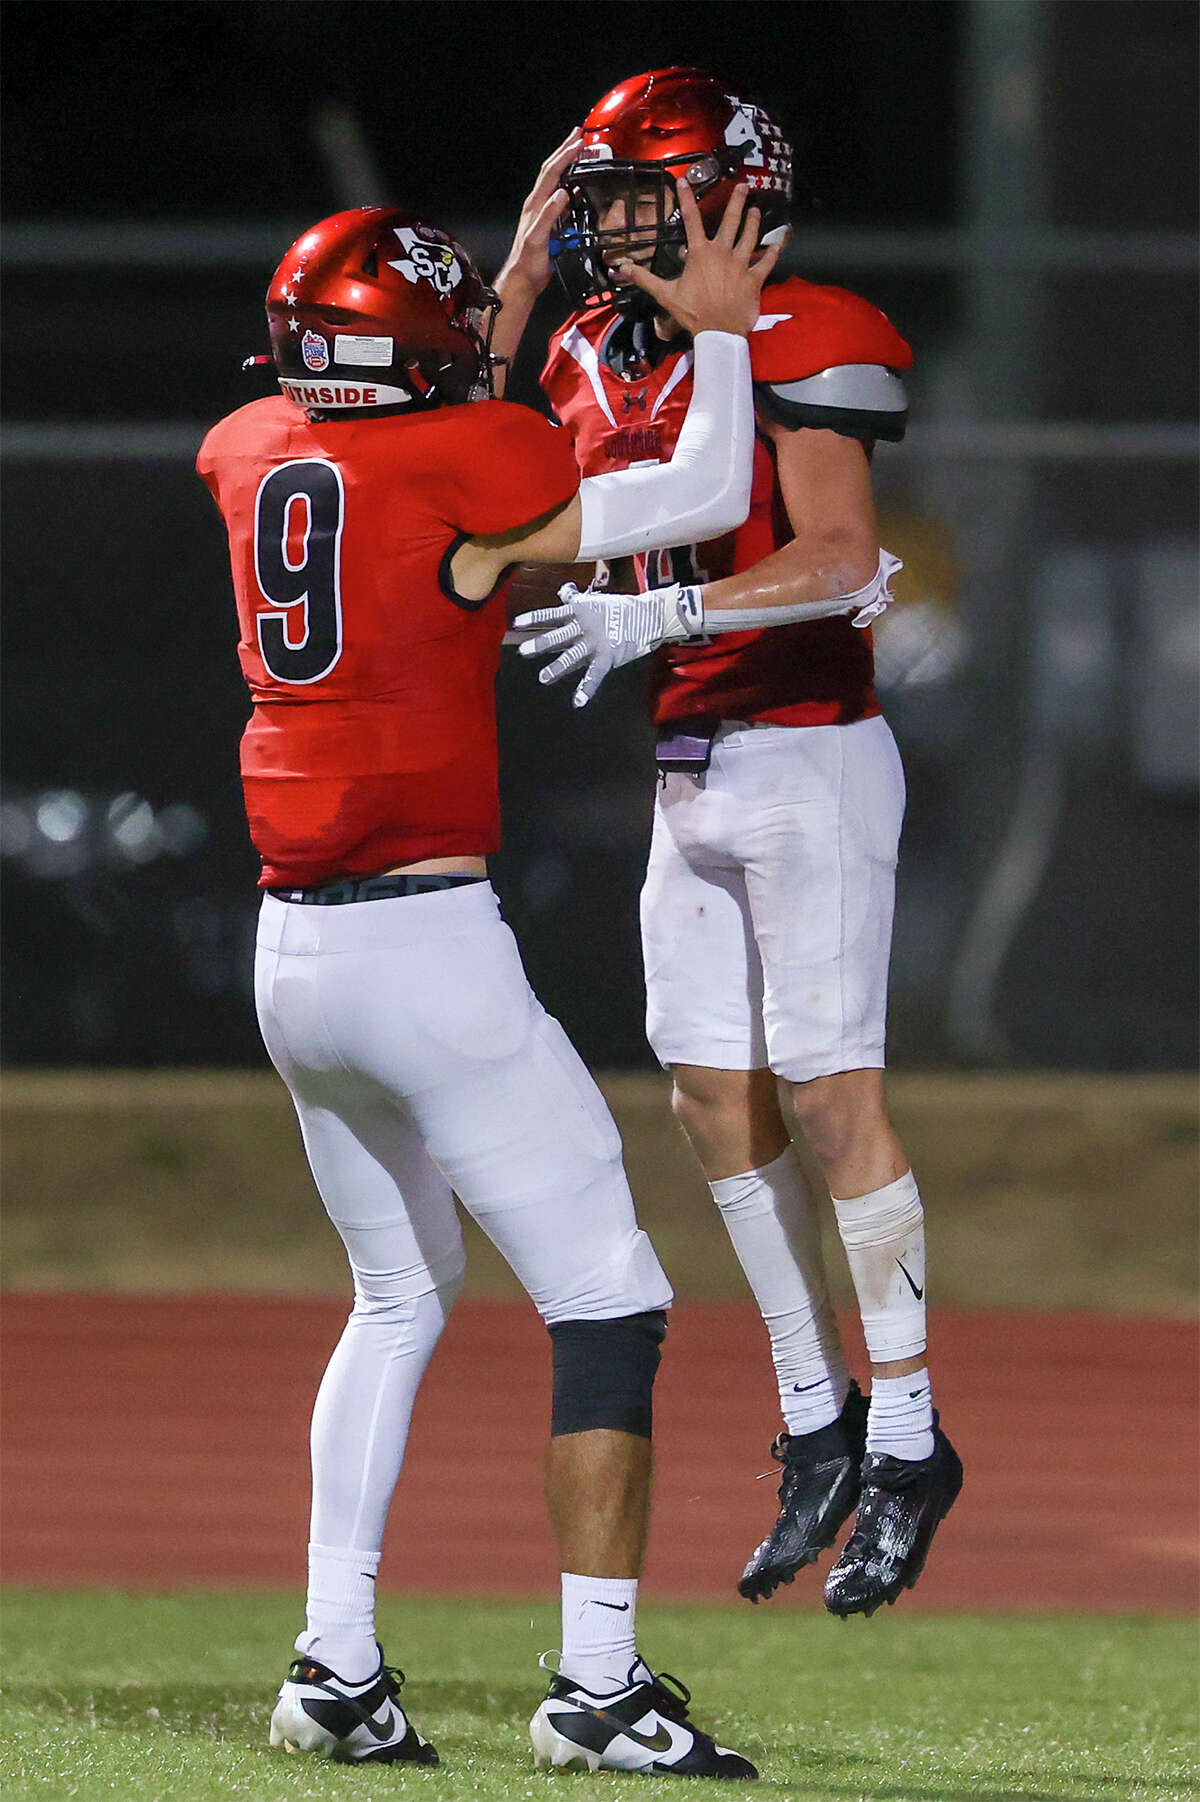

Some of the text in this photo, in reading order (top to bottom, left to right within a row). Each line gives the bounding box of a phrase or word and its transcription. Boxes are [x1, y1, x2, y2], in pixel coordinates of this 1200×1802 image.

[409, 245, 454, 294] SC
[286, 386, 377, 404] UTHSIDE
[254, 457, 345, 685] 9
